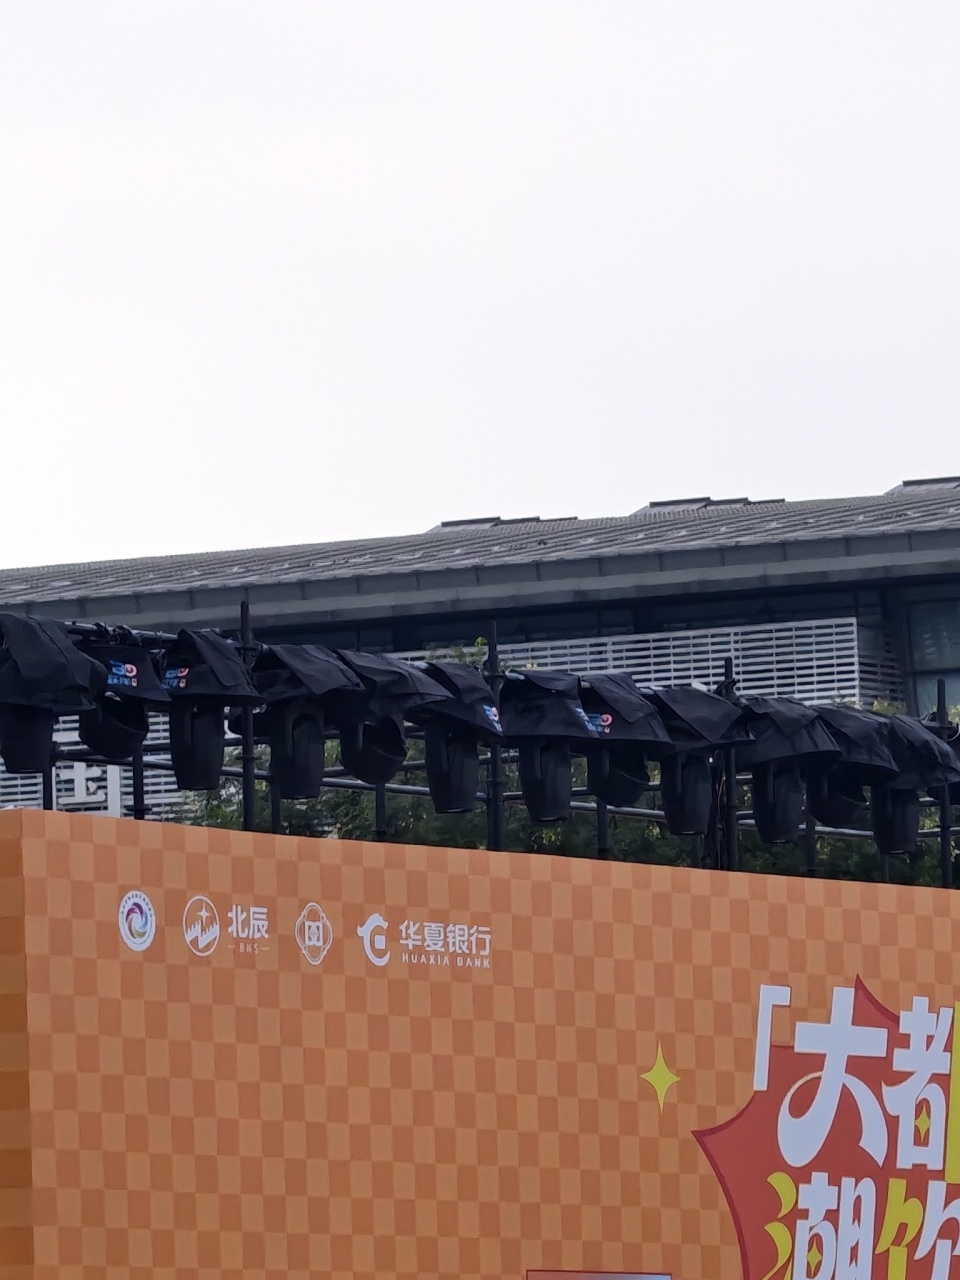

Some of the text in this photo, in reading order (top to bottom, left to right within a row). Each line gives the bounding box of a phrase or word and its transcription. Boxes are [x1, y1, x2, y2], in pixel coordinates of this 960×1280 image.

[227, 903, 270, 940] 北辰
[399, 919, 492, 956] 华夏银行
[402, 952, 491, 969] HUAXIA BANK
